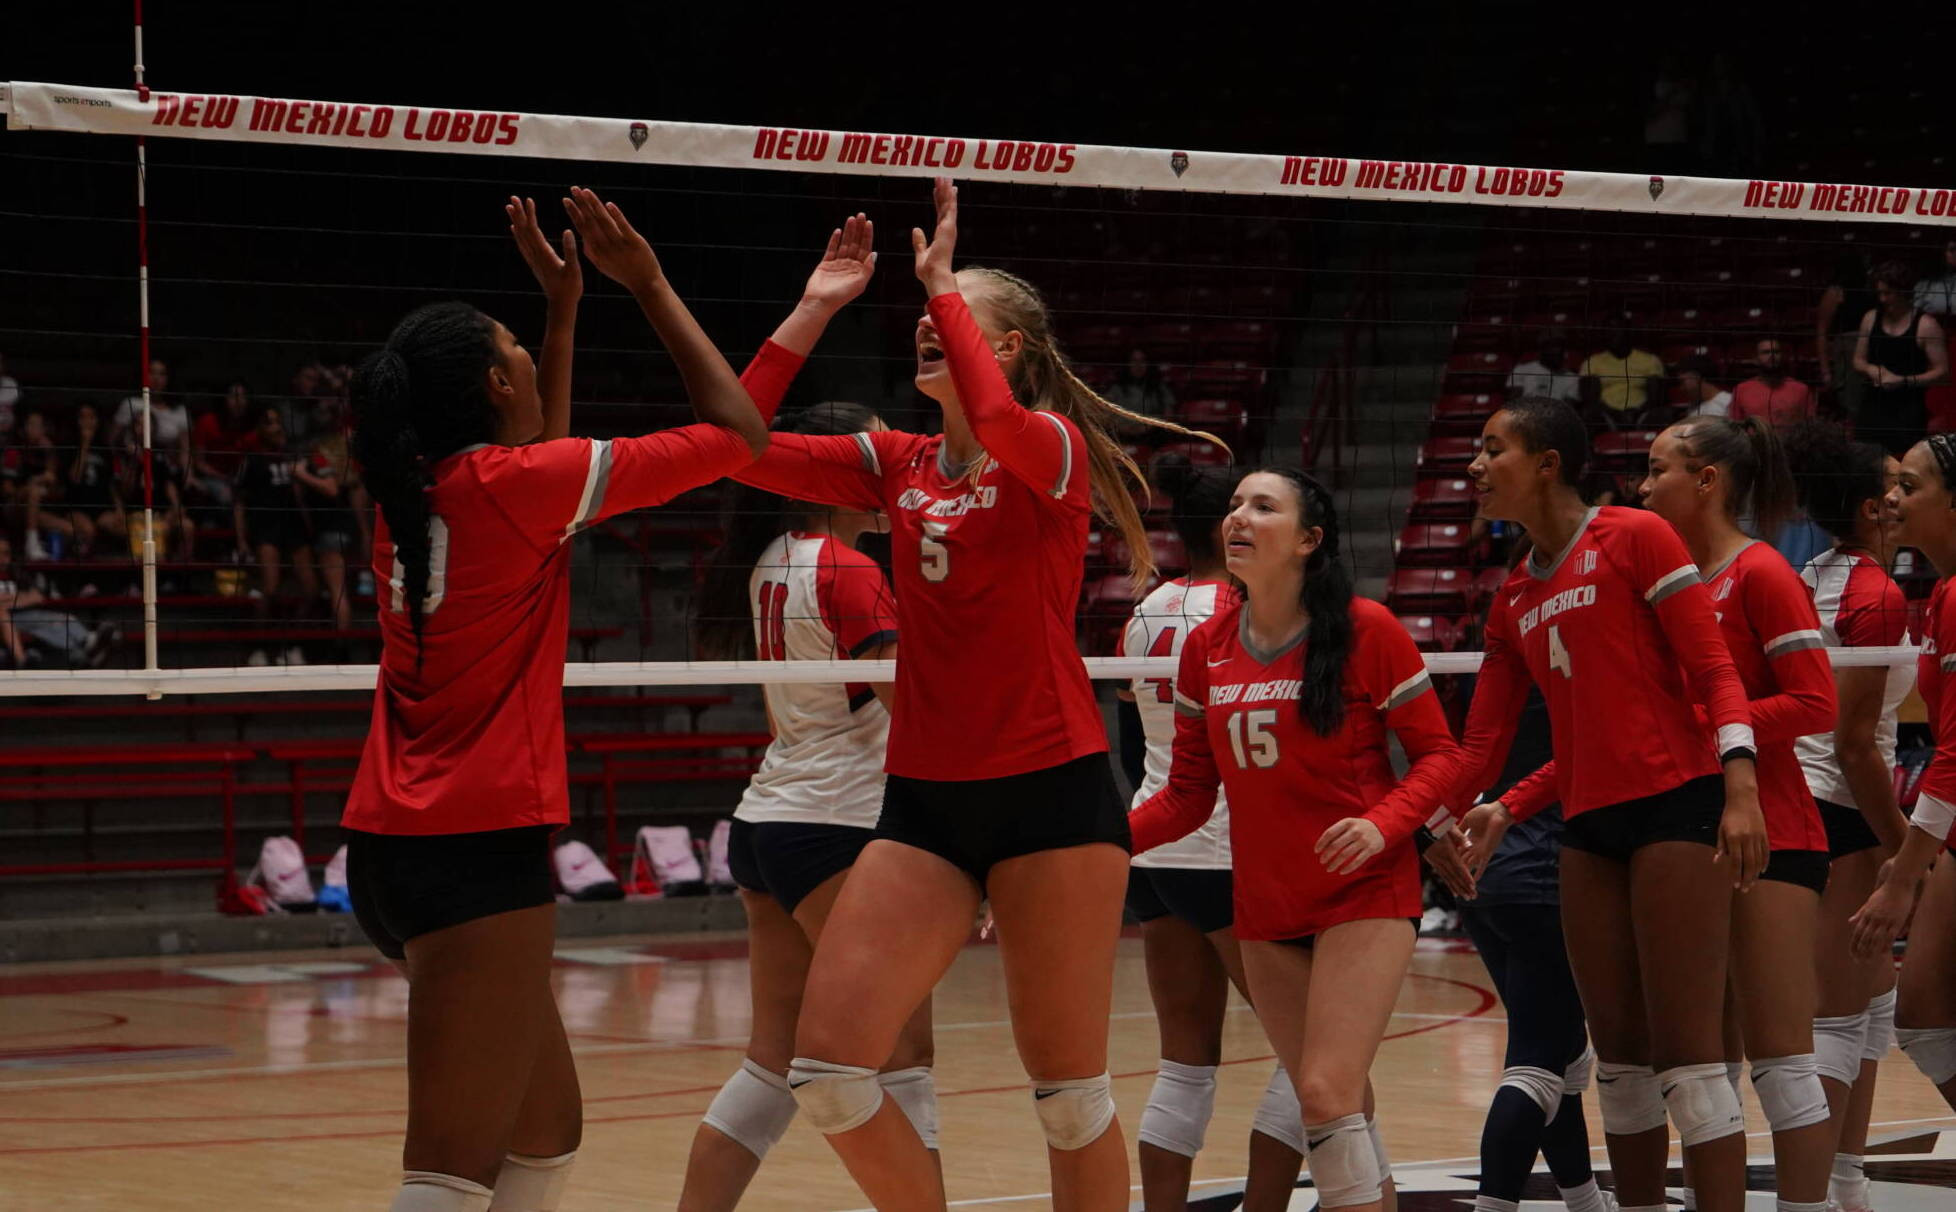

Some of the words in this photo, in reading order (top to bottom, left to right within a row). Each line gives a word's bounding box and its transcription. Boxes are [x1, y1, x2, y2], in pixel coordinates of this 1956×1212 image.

[152, 95, 239, 129] NEW
[249, 99, 394, 138] MEXICO
[404, 109, 520, 145] LOBOS
[753, 128, 830, 162] NEW
[837, 133, 965, 168] MEXICO
[973, 140, 1077, 173] LOBOS
[1280, 157, 1348, 187] NEW
[1354, 160, 1467, 193] MEXICO
[1475, 167, 1565, 197] LOBOS
[1744, 180, 1804, 209] NEW
[1810, 183, 1910, 214] MEXICO
[920, 520, 949, 583] 5
[1541, 584, 1597, 622] MEXICO
[1548, 624, 1573, 679] 4
[1208, 683, 1245, 707] NEW
[1240, 679, 1305, 703] MEXIC
[1227, 708, 1279, 770] 15
